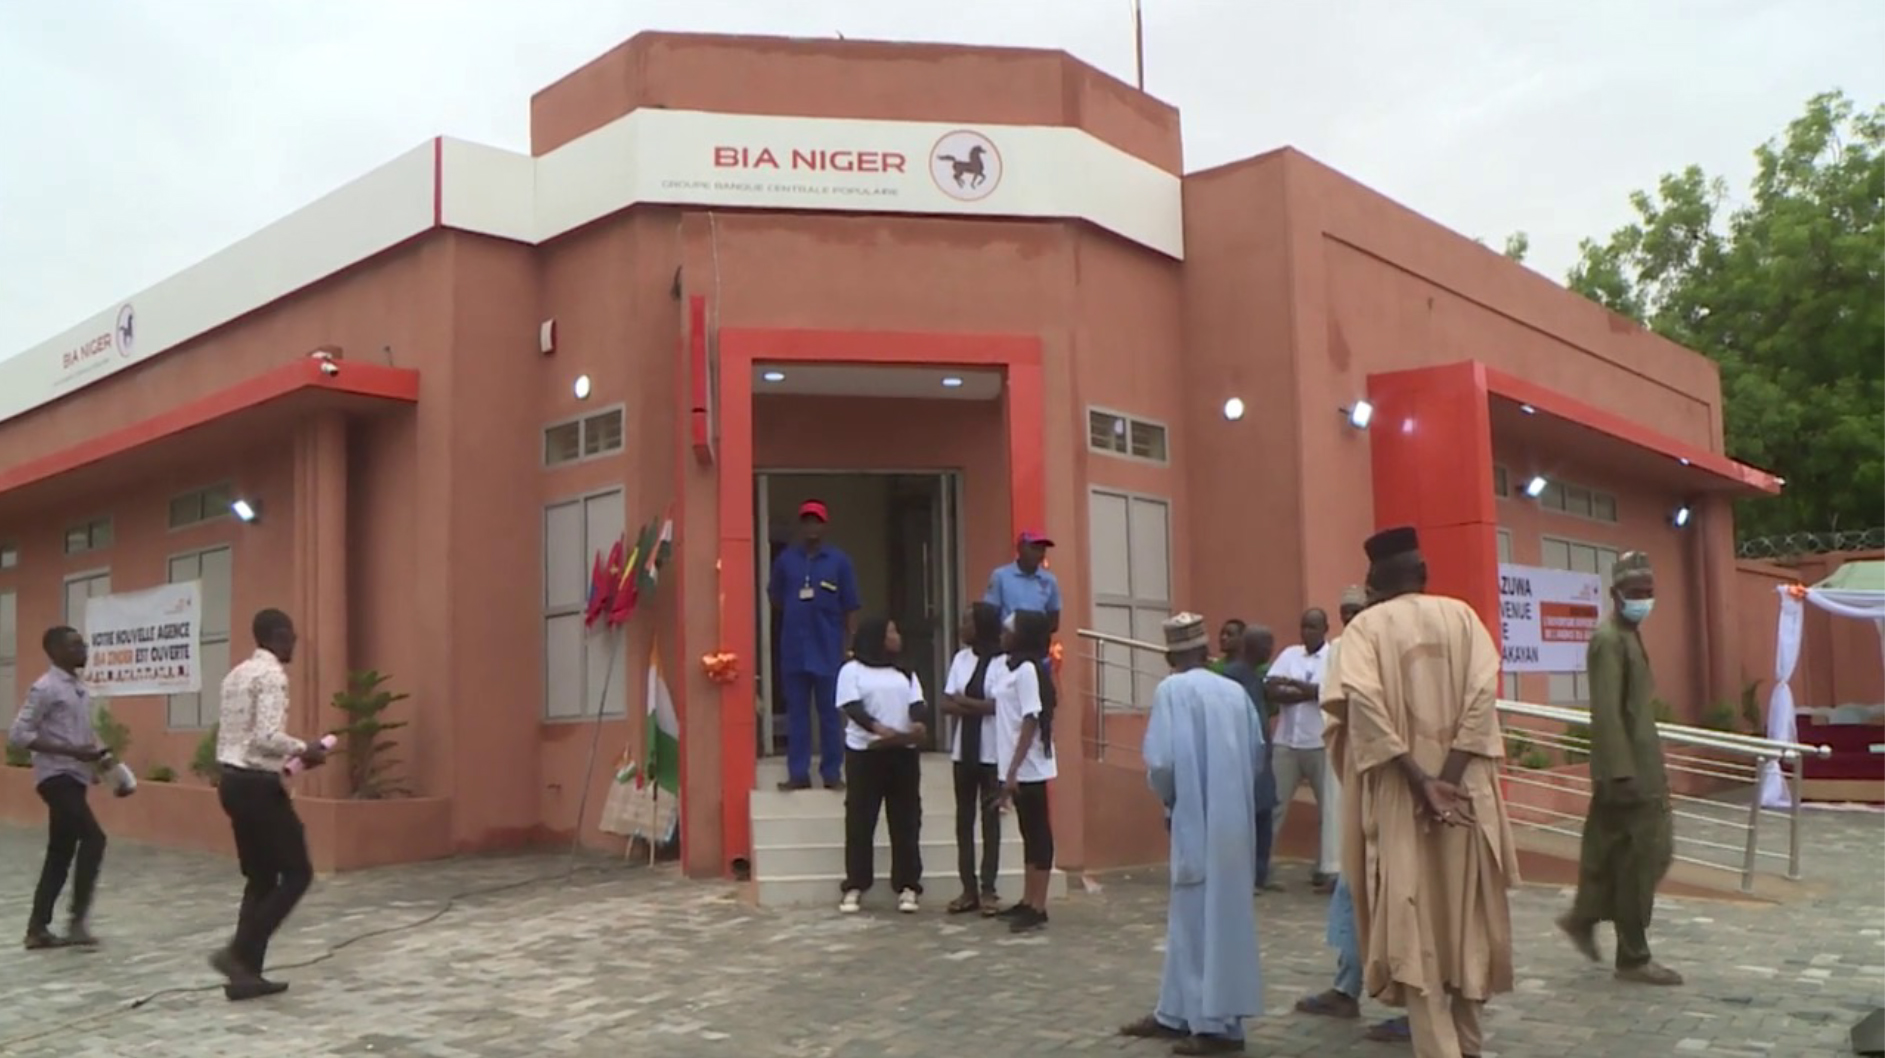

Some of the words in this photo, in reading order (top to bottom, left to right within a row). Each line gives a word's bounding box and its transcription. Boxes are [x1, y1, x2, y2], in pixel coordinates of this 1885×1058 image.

[713, 146, 779, 169] BIA
[791, 148, 907, 173] NIGER
[661, 179, 711, 191] GROUPE
[713, 181, 763, 193] BANQUE
[767, 183, 829, 195] CENTRALE
[832, 185, 898, 197] POPULAIRE
[62, 349, 79, 369] BIA
[80, 332, 112, 360] NIGER
[1501, 576, 1533, 597] ZUWA
[91, 631, 114, 647] VOTRE
[116, 626, 155, 645] NOUVELLE
[157, 621, 190, 640] AGENCE
[135, 647, 149, 663] EST
[151, 643, 190, 662] OUVERTE
